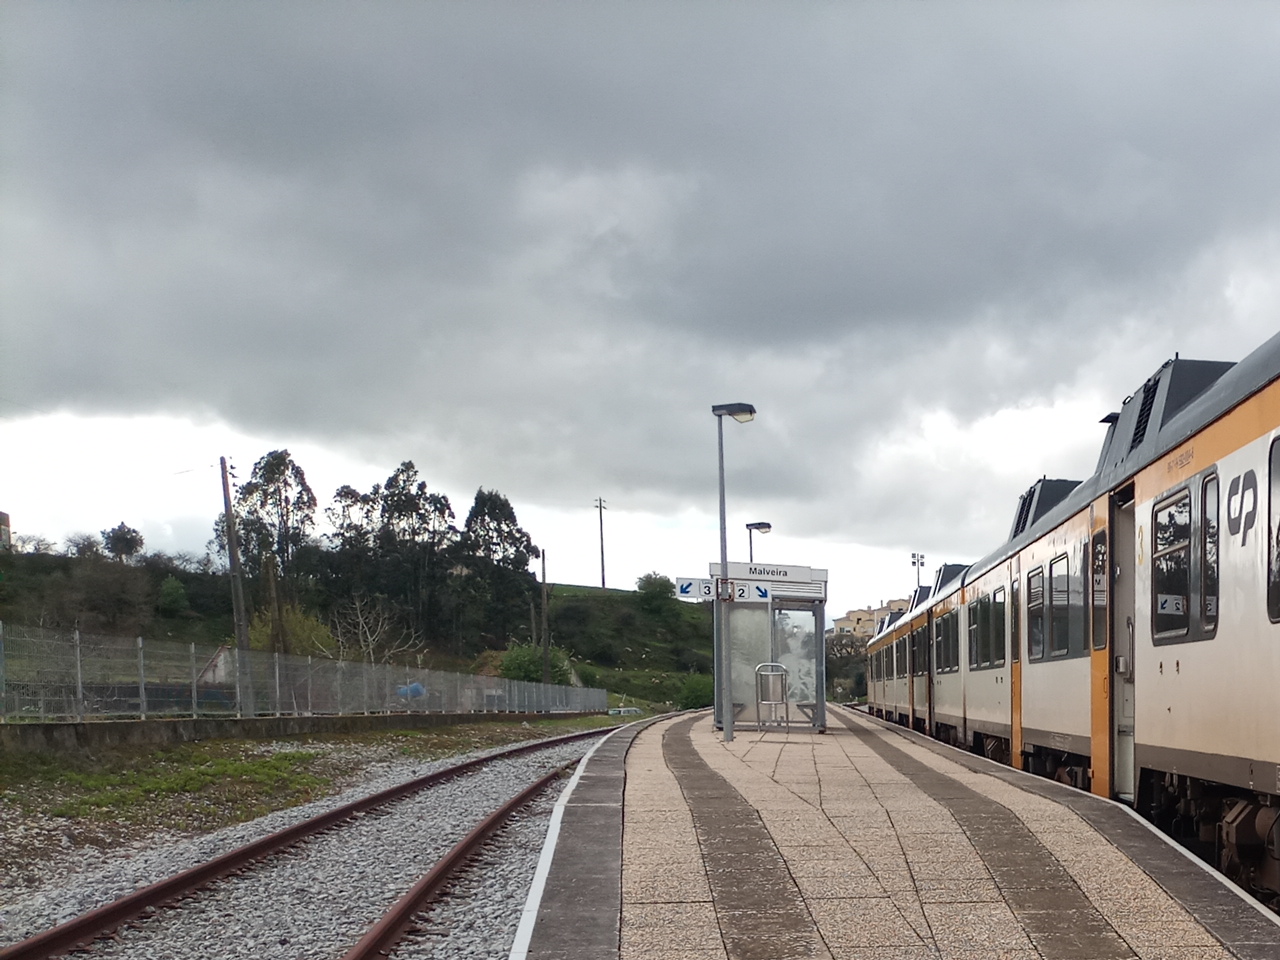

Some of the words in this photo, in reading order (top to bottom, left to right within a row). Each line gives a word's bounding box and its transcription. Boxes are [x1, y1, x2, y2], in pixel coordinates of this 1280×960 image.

[749, 567, 788, 577] Malveira
[703, 585, 711, 595] 3
[738, 588, 745, 598] 2
